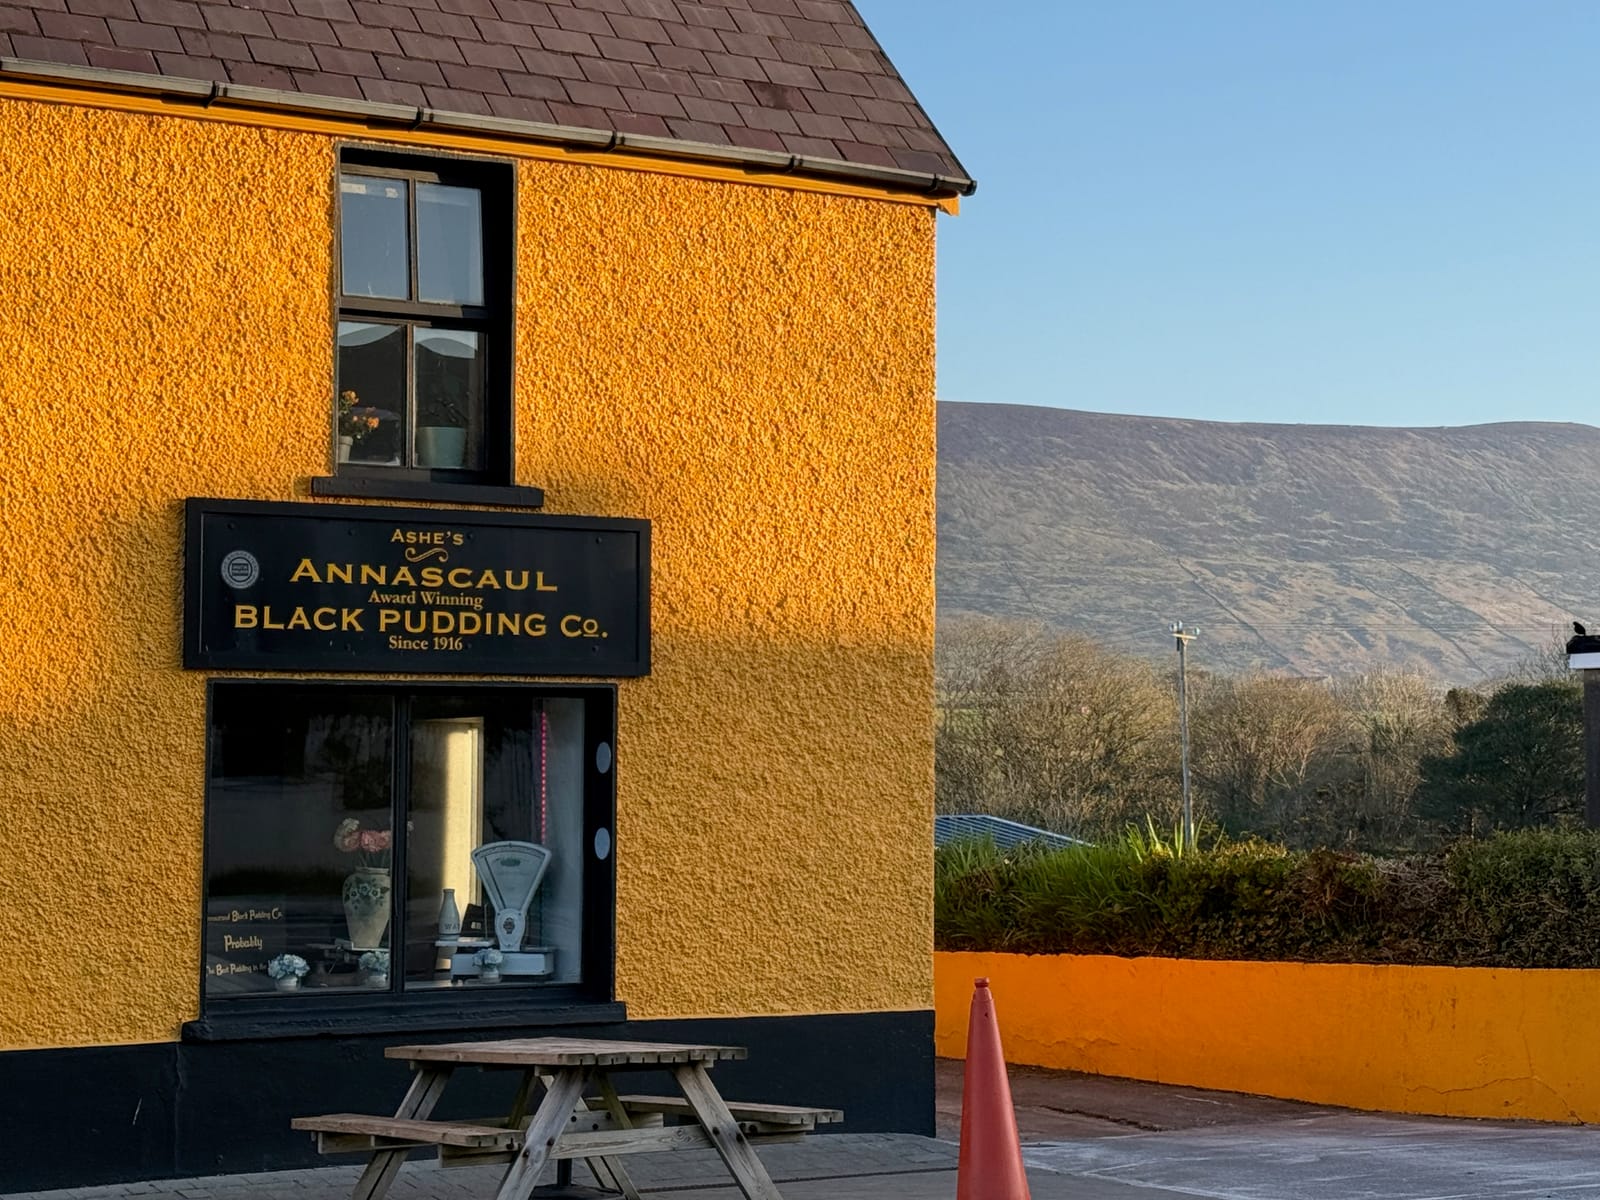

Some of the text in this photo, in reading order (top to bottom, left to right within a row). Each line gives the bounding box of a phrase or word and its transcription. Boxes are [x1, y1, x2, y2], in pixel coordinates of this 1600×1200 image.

[391, 528, 464, 546] ASHE'S
[289, 558, 558, 592] ANNASCAUL
[368, 590, 484, 610] Award Winning
[234, 604, 364, 632] BLACK
[379, 610, 547, 637] PUDDING
[389, 635, 463, 651] Since 1916
[224, 934, 263, 952] Probably
